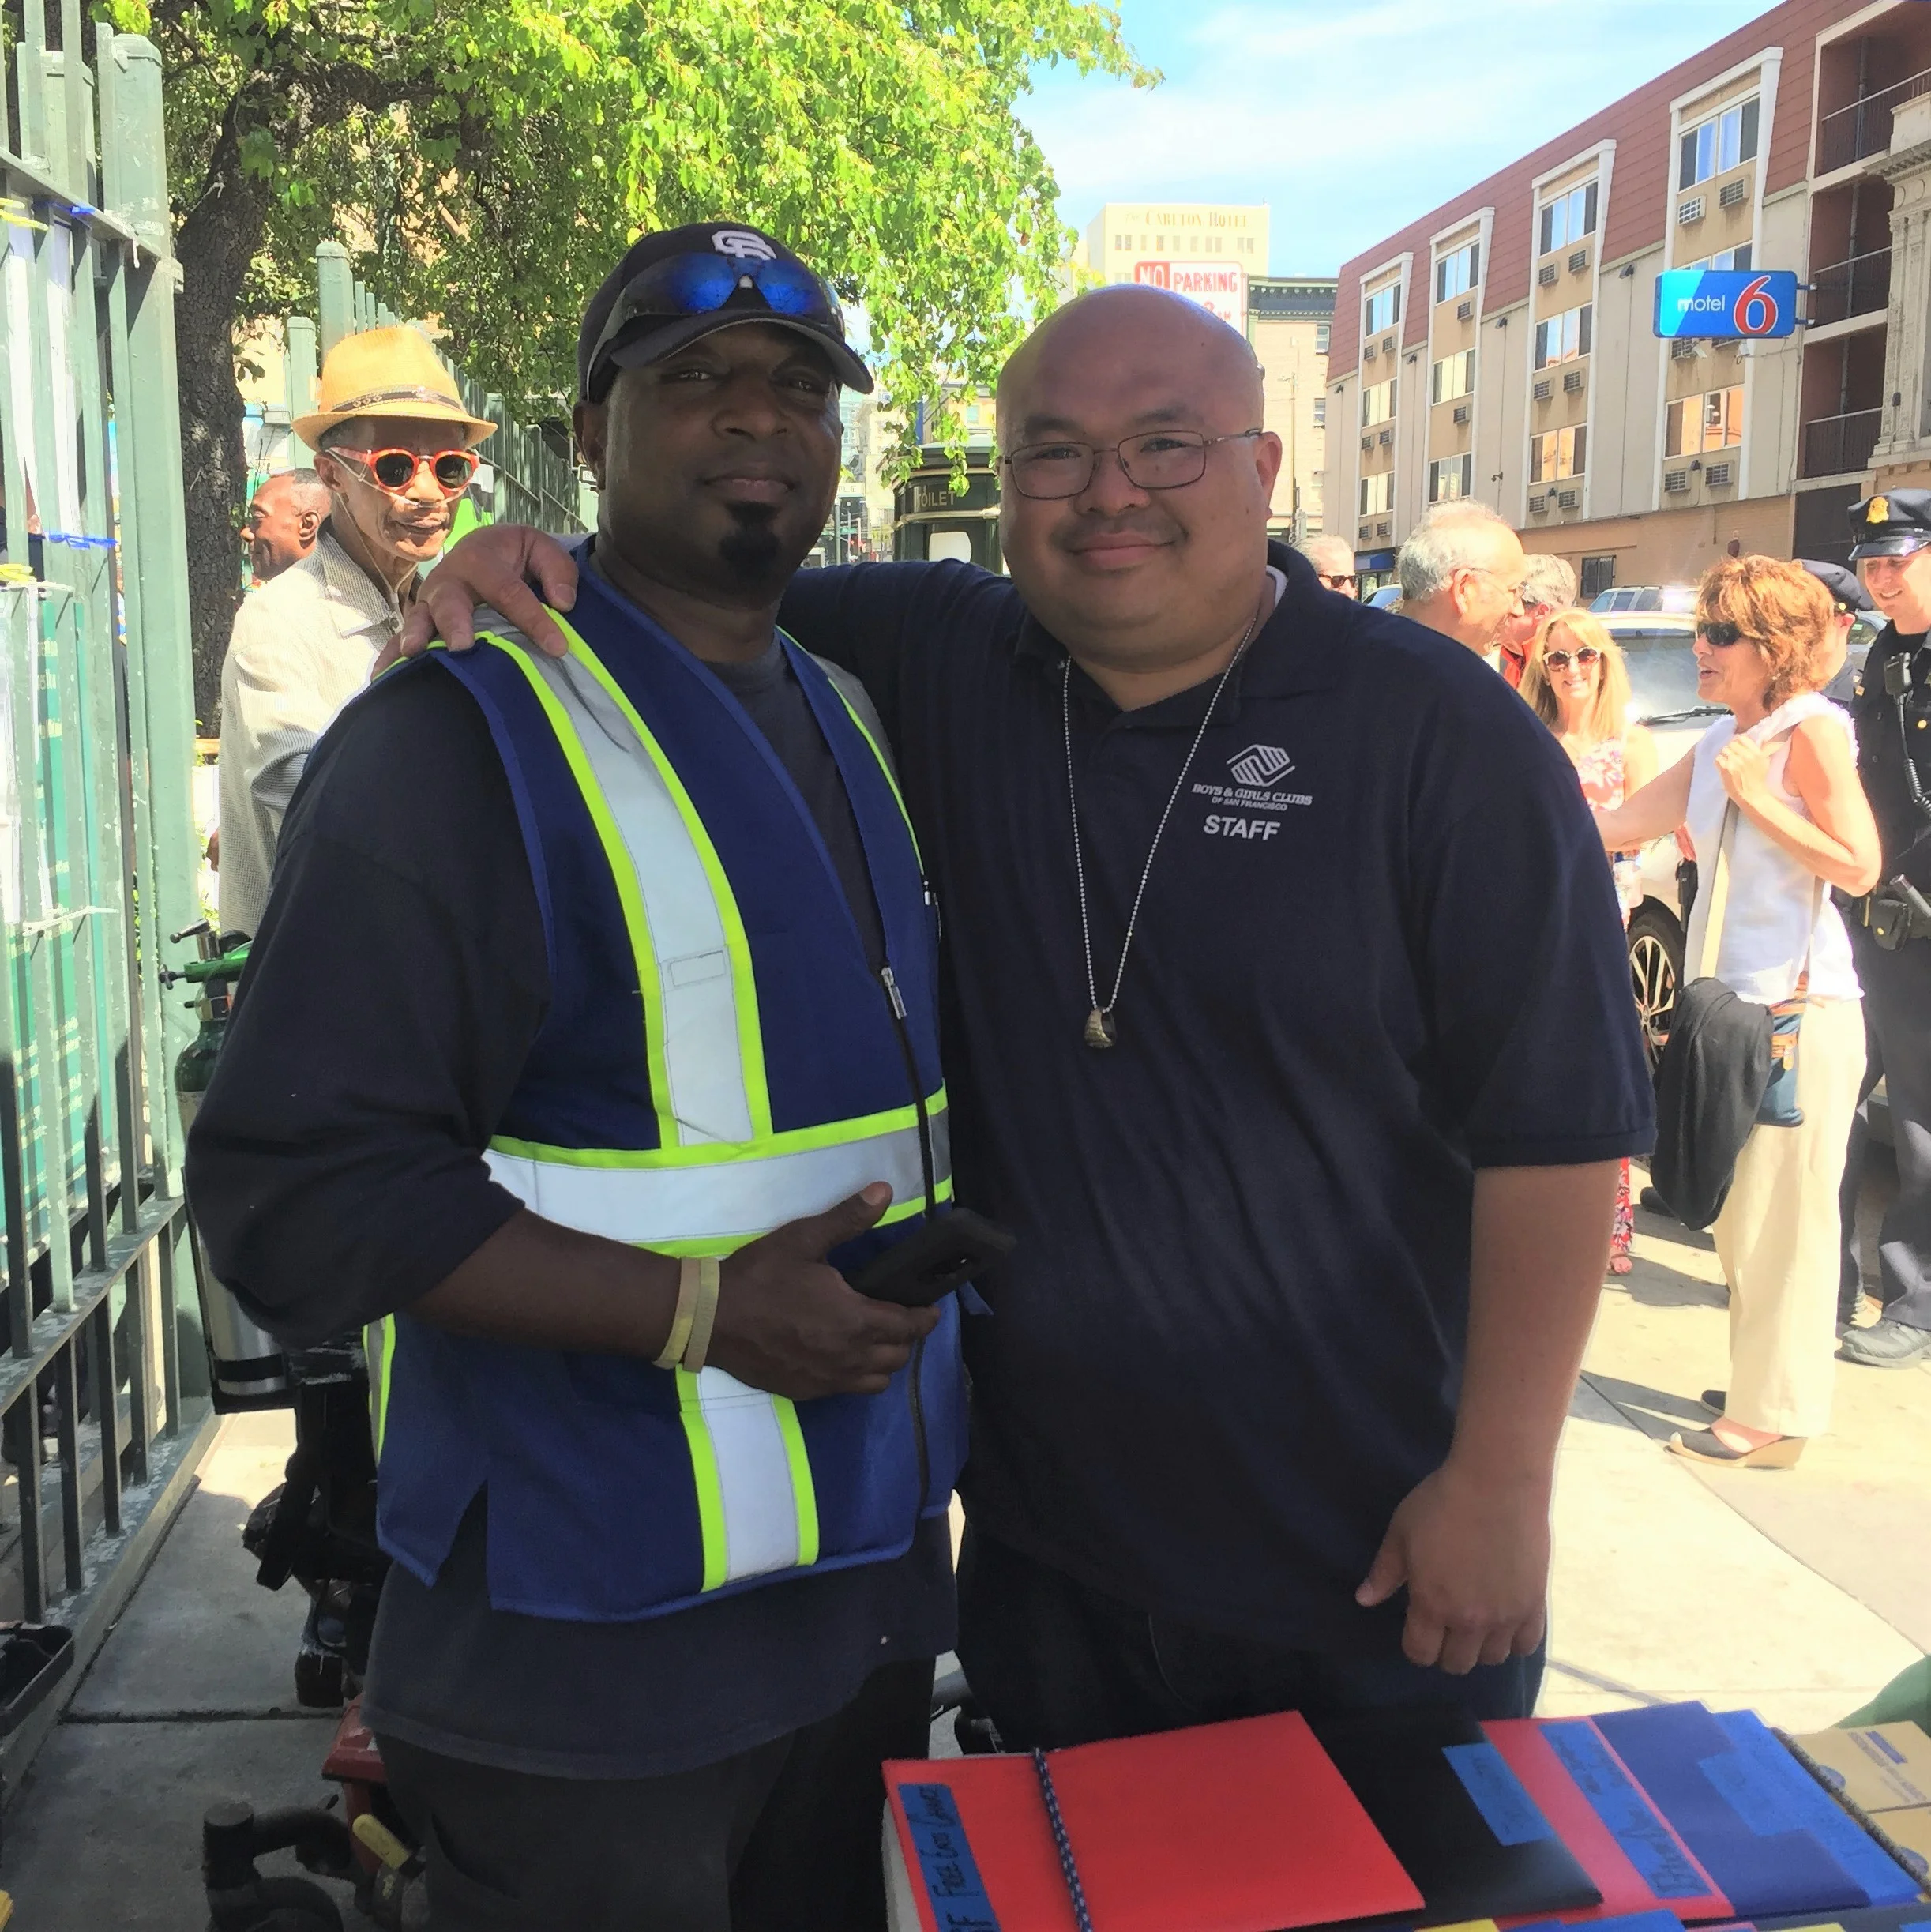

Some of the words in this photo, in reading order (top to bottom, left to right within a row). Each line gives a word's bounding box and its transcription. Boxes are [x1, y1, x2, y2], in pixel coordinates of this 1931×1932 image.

[1209, 211, 1250, 227] HOTEL
[1139, 265, 1165, 288] NO
[1173, 272, 1238, 292] PARKING
[1677, 295, 1726, 312] motel
[1733, 275, 1779, 335] 6
[1191, 783, 1223, 796] BOYS
[1223, 787, 1233, 797] &
[1234, 788, 1272, 802] GIRLS
[1272, 791, 1313, 806] CLUBS
[1223, 798, 1240, 806] SAN
[1240, 799, 1288, 812] FRANCISCO
[1203, 814, 1281, 841] STAFF
